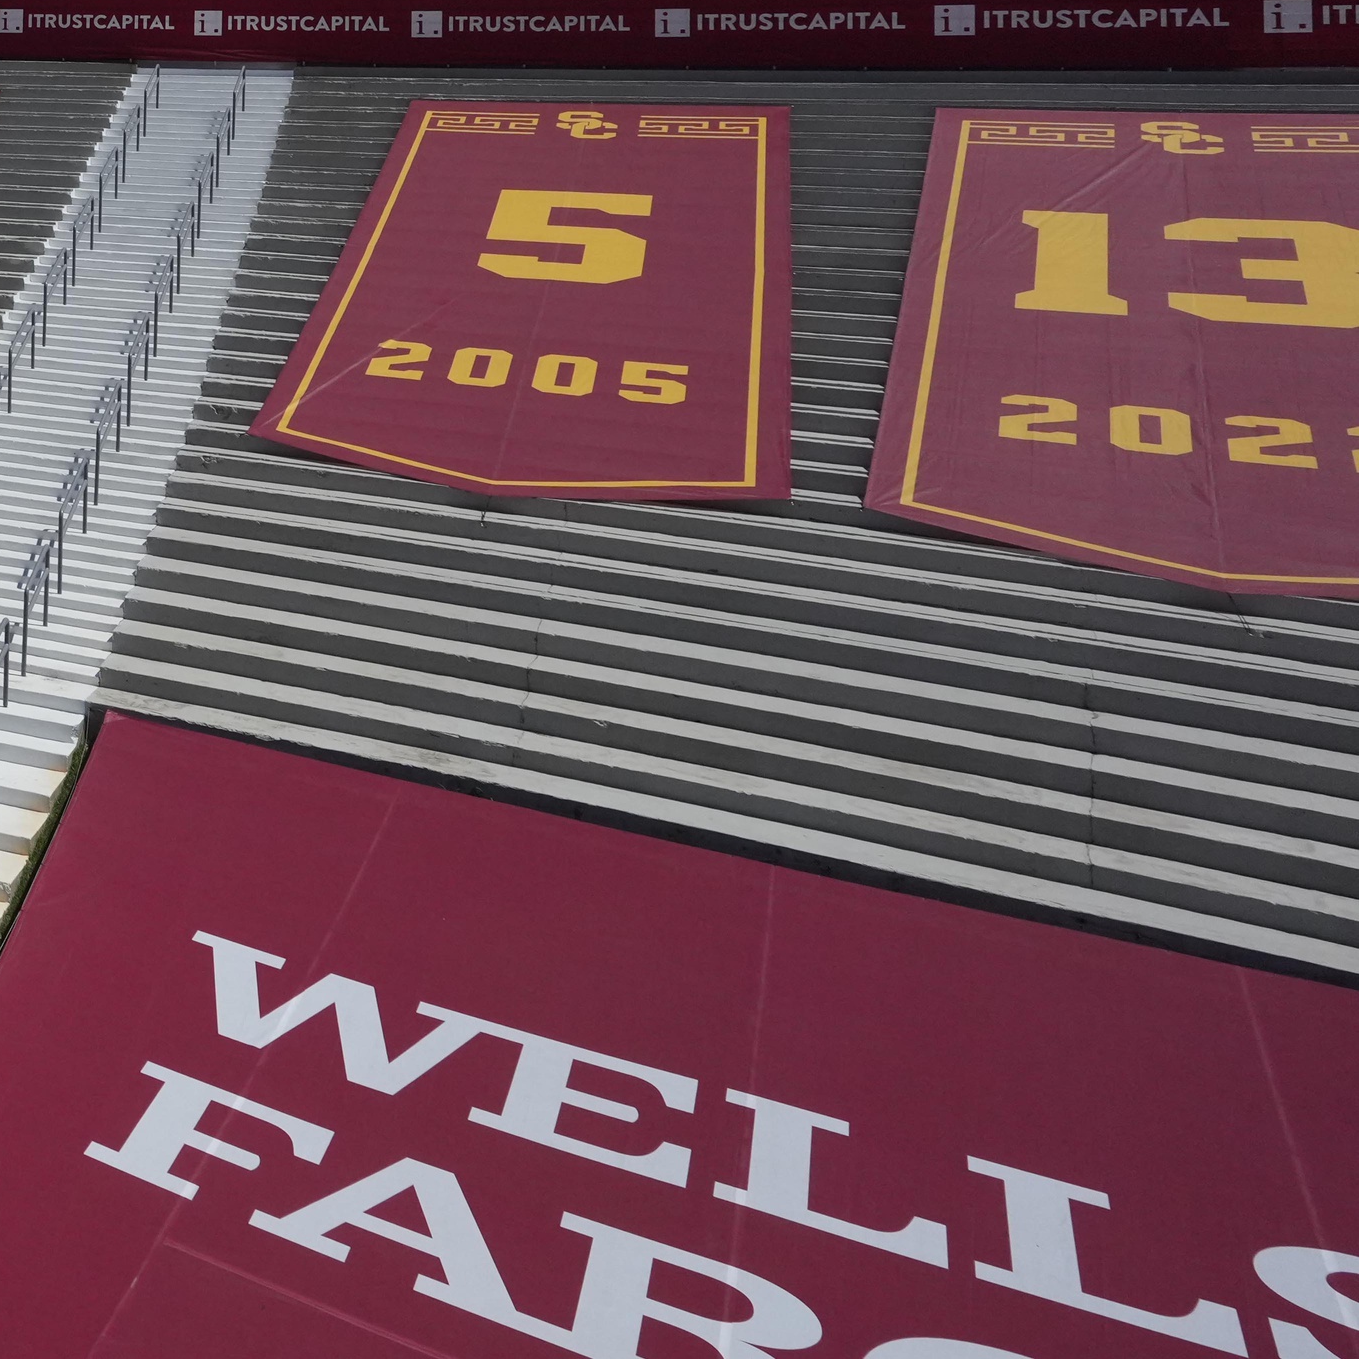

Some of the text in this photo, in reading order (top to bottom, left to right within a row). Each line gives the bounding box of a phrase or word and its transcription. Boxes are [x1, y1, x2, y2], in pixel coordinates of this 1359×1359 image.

[27, 13, 175, 30] ITRUSTCAPITAL
[227, 15, 390, 32] ITRUSTCAPITAL
[448, 14, 631, 32] ITRUSTCAPITAL
[697, 11, 906, 31] ITRUSTCAPITAL
[983, 7, 1230, 29] ITRUSTCAPITAL
[478, 189, 653, 284] 5
[1015, 210, 1359, 329] 13
[366, 339, 689, 405] 2005
[999, 394, 1359, 472] 202
[83, 1060, 1032, 1359] FAR
